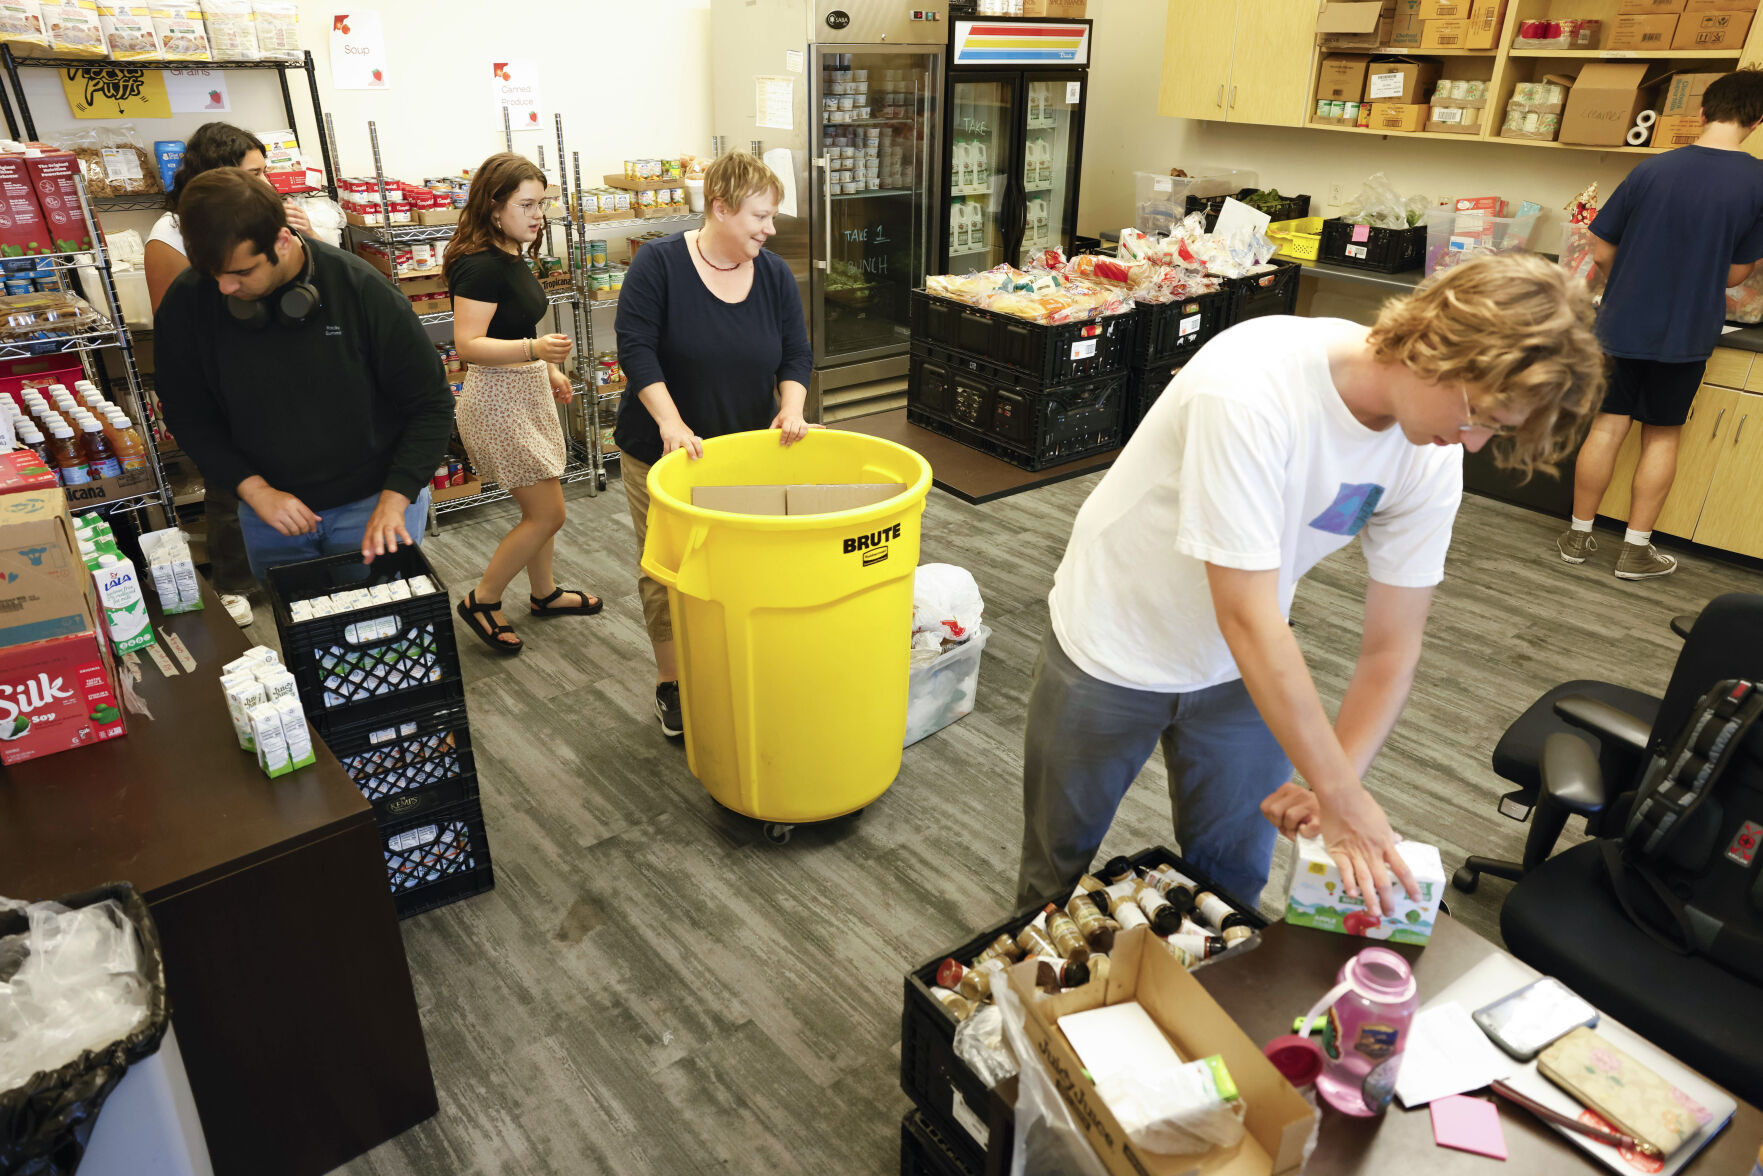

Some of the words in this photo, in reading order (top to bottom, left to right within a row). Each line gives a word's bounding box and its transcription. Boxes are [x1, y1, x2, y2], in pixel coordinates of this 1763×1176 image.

[344, 44, 370, 56] Soup
[85, 77, 144, 107] Puffs
[501, 85, 532, 94] Canned
[501, 98, 534, 106] Produce
[962, 117, 989, 136] TAKE
[844, 228, 868, 242] TAKE
[847, 255, 888, 276] BUNCH
[843, 522, 901, 555] BRUTE
[104, 574, 132, 592] LALA
[272, 682, 294, 695] Juicy
[0, 672, 74, 724] Silk
[31, 713, 56, 723] soy
[390, 796, 418, 811] KEMPS
[1038, 1040, 1075, 1091] Juicy
[1074, 1089, 1114, 1149] Juice
